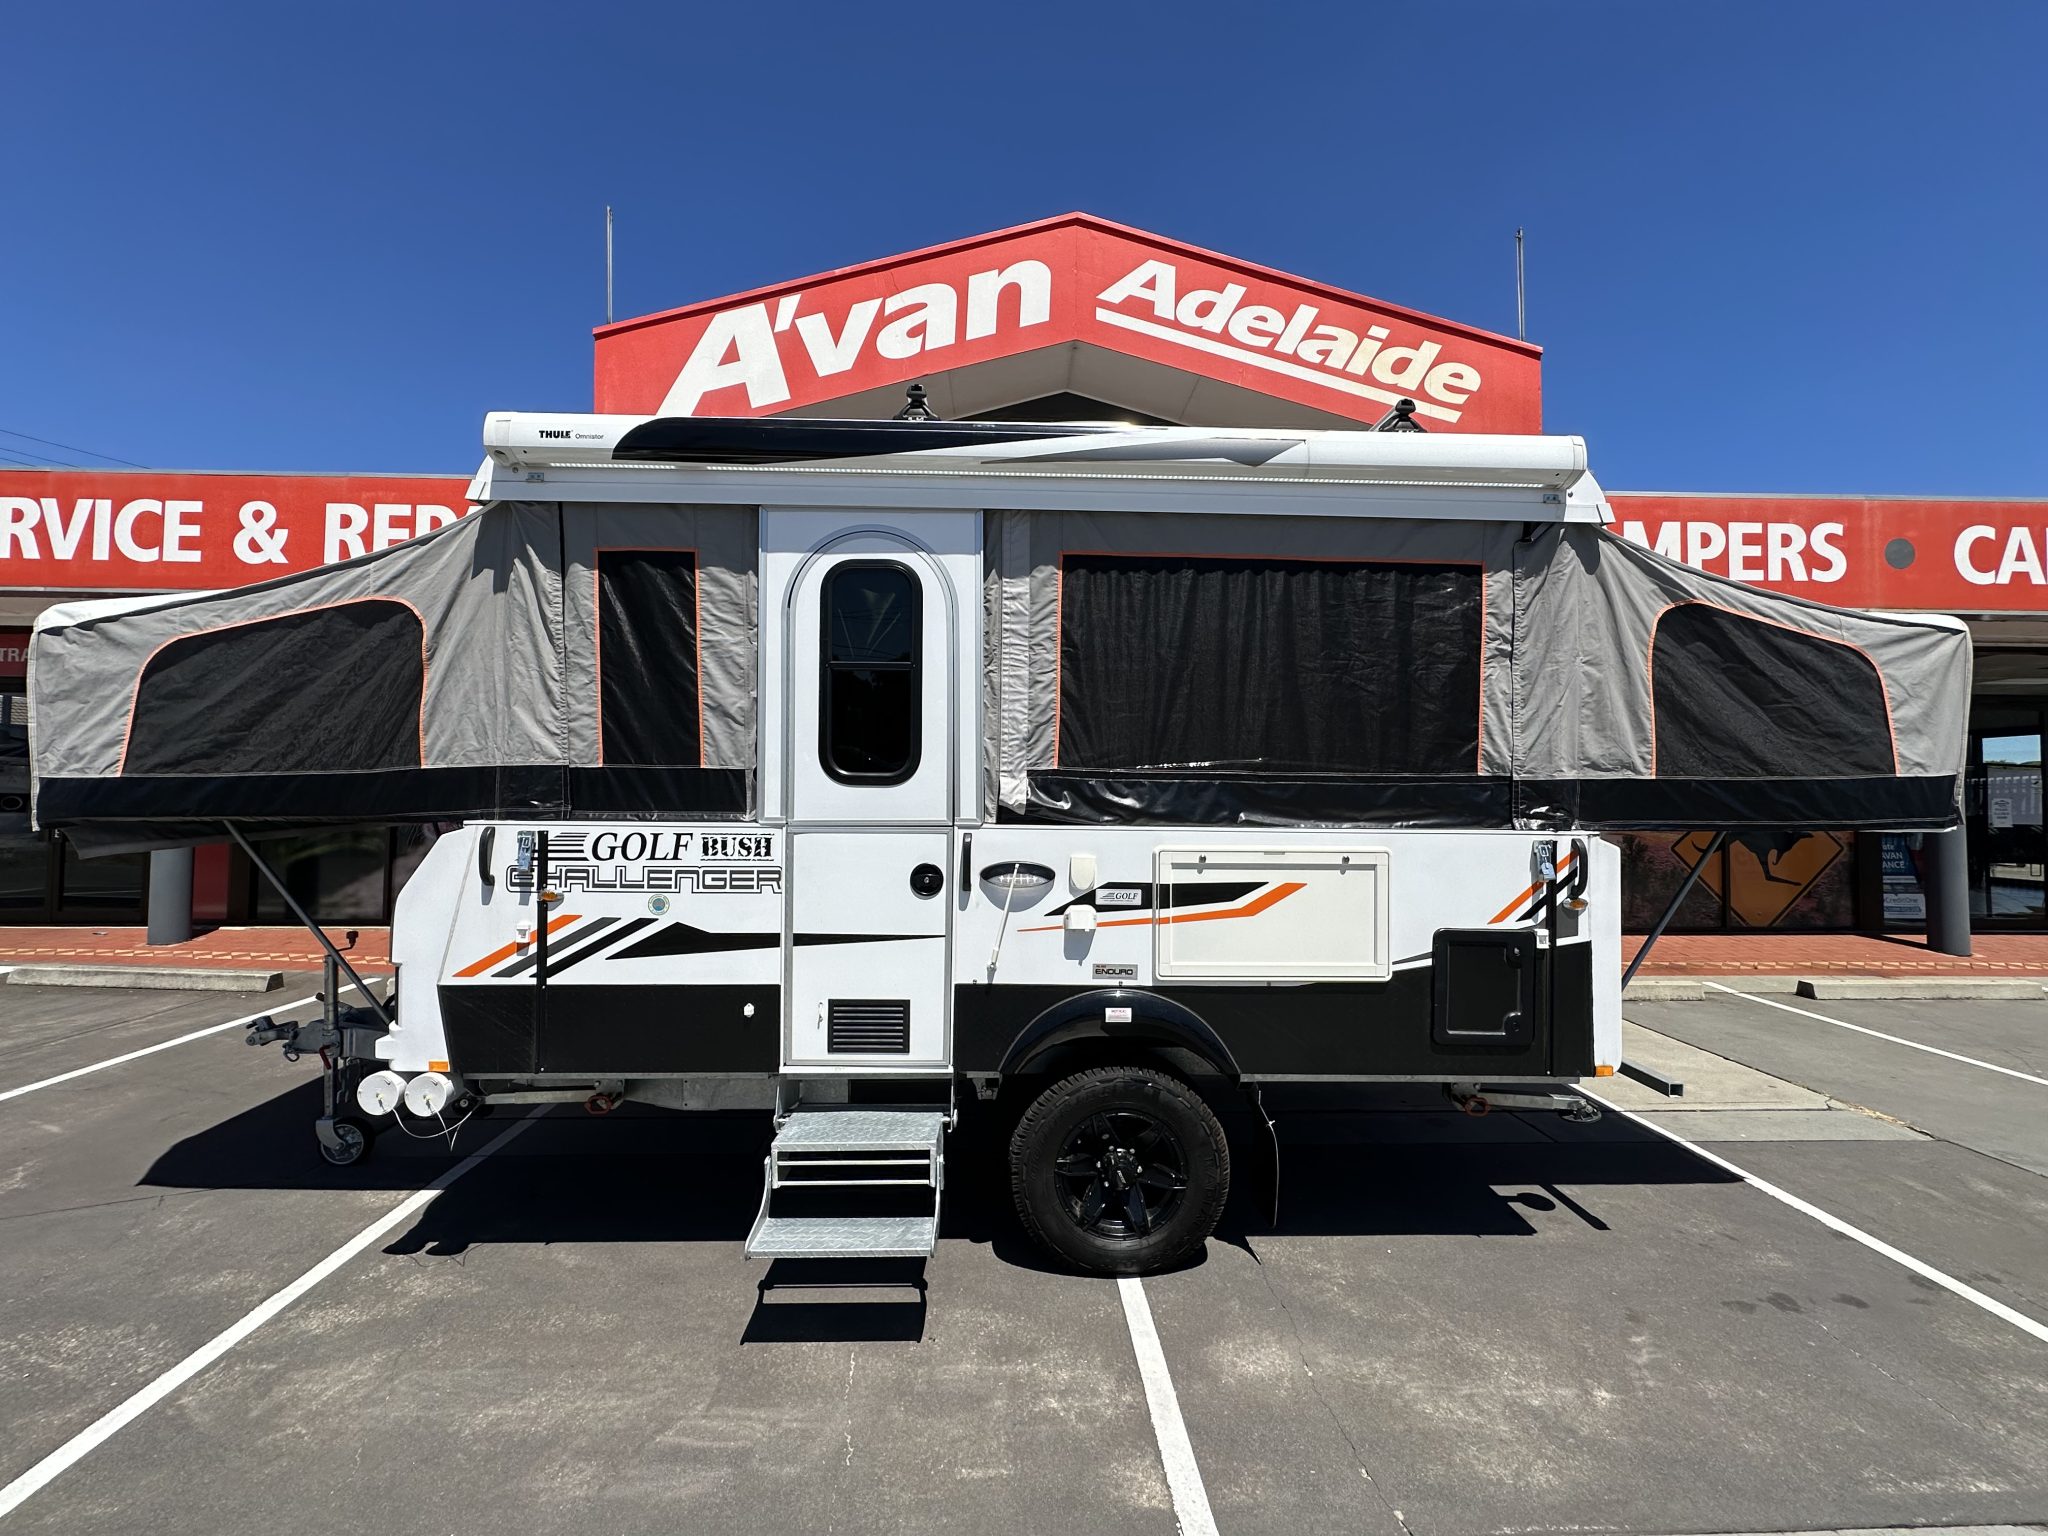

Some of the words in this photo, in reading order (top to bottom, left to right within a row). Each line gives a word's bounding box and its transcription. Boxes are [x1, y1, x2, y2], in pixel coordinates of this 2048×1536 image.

[1096, 259, 1481, 404] Adelaide
[539, 430, 571, 439] THULE
[0, 497, 203, 562] RVICE
[233, 501, 289, 564] &
[1602, 521, 1847, 583] MPERS
[1954, 525, 2048, 585] CA
[592, 832, 694, 862] GOLF
[701, 836, 772, 858] BUSH
[1115, 892, 1138, 900] GOLF
[1095, 968, 1134, 976] ENDURO
